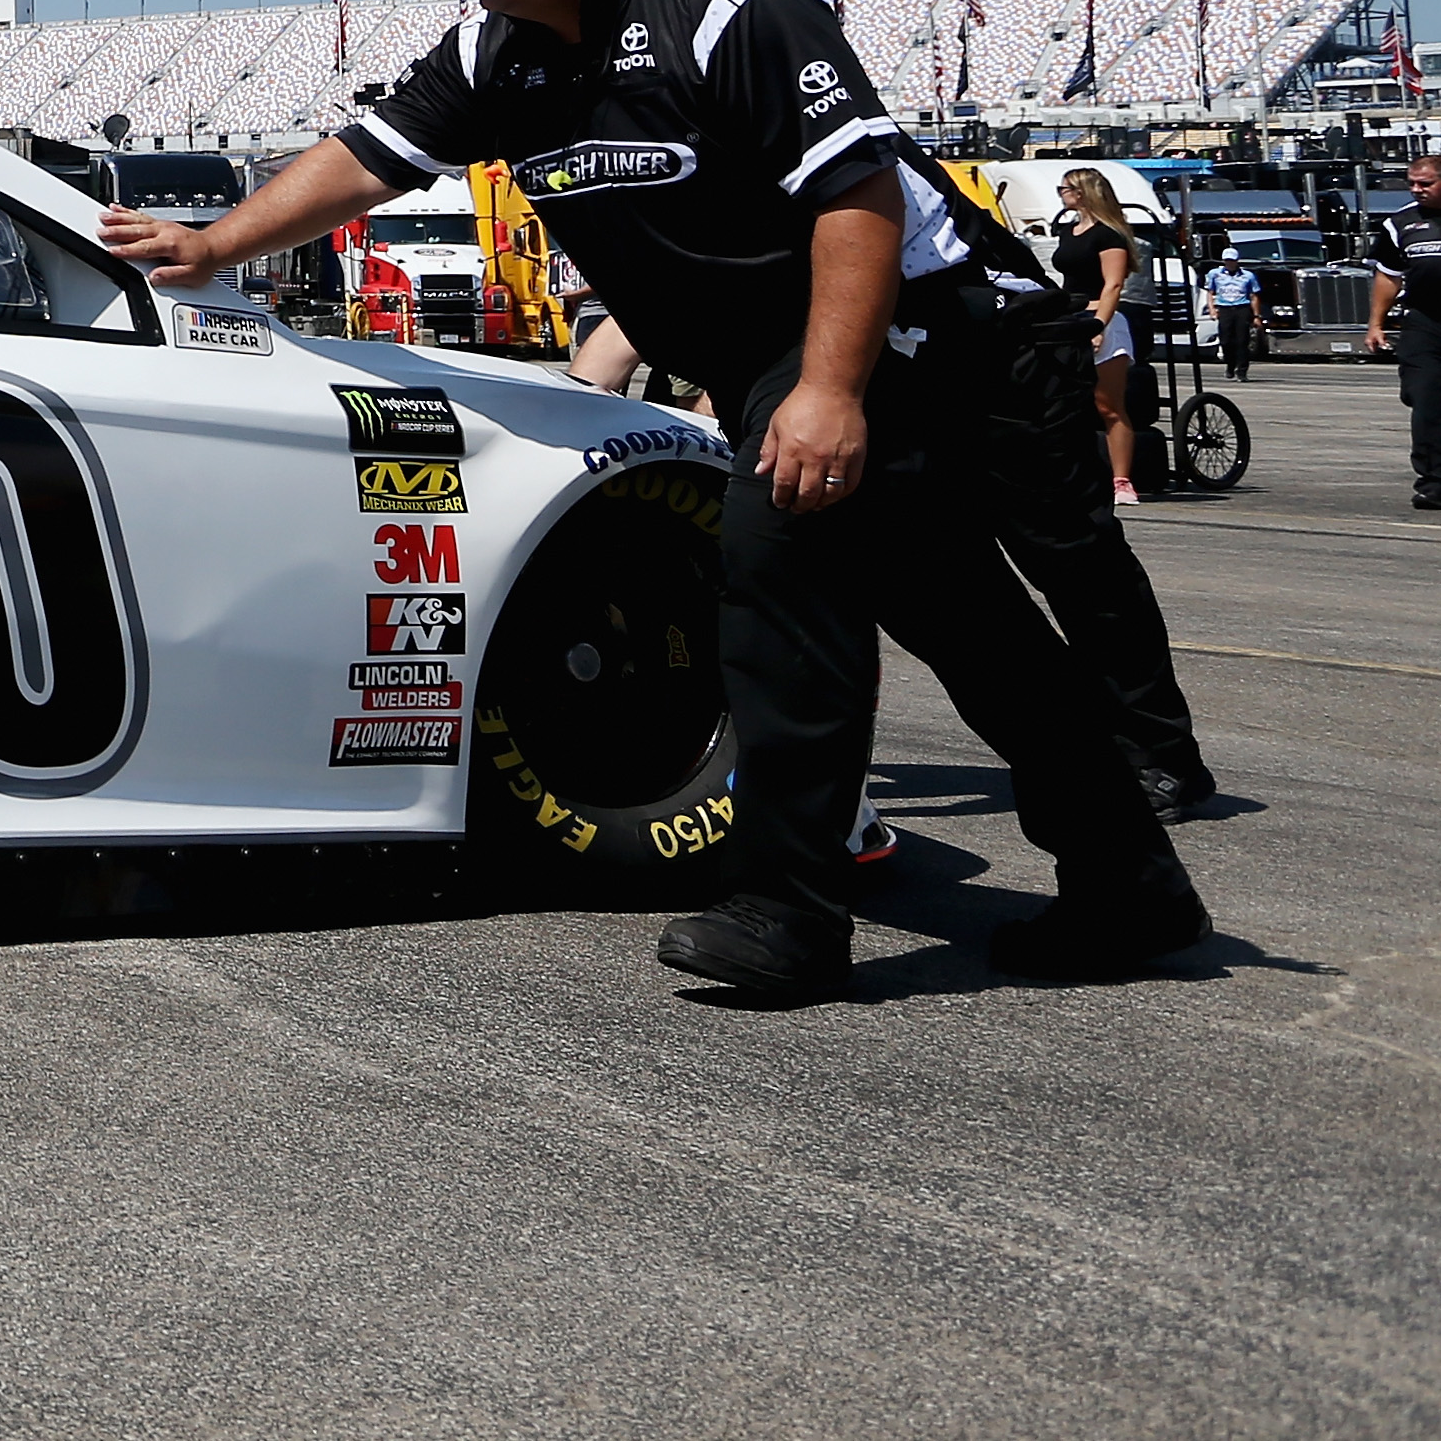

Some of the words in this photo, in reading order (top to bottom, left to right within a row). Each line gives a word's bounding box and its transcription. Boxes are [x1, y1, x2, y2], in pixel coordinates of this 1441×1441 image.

[803, 87, 850, 119] TOYO
[204, 313, 259, 333] NASCAR
[189, 330, 227, 344] RACE
[231, 334, 260, 348] CAR
[377, 397, 449, 413] MONSTER
[362, 494, 425, 511] MECHANIX
[426, 496, 464, 511] WEAR
[373, 523, 461, 584] 3M
[354, 665, 443, 687] LINCOLN
[371, 690, 452, 708] WELDERS
[336, 721, 453, 759] FLOWMASTER
[475, 705, 599, 853] EAGLE
[650, 768, 737, 859] 4750
